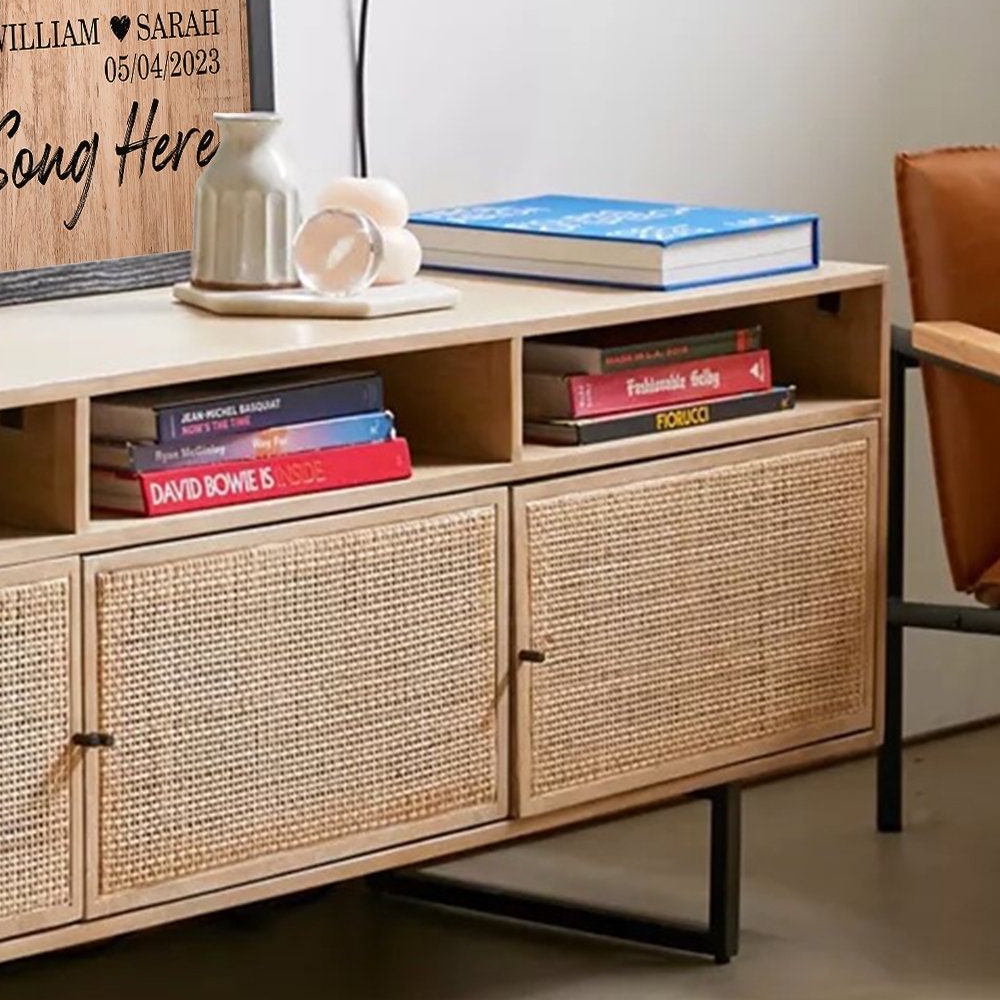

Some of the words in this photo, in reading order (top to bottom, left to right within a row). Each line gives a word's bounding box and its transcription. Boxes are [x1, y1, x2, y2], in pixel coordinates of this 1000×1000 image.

[137, 8, 220, 41] SARAH
[104, 47, 220, 83] 05/04/2023
[115, 97, 221, 186] Here
[239, 398, 281, 414] BASQUIAT
[656, 406, 710, 430] FIORUCCI
[150, 475, 203, 506] DAVID
[204, 469, 259, 498] BOWIE
[260, 466, 275, 489] IS
[277, 460, 327, 488] INSIDE
